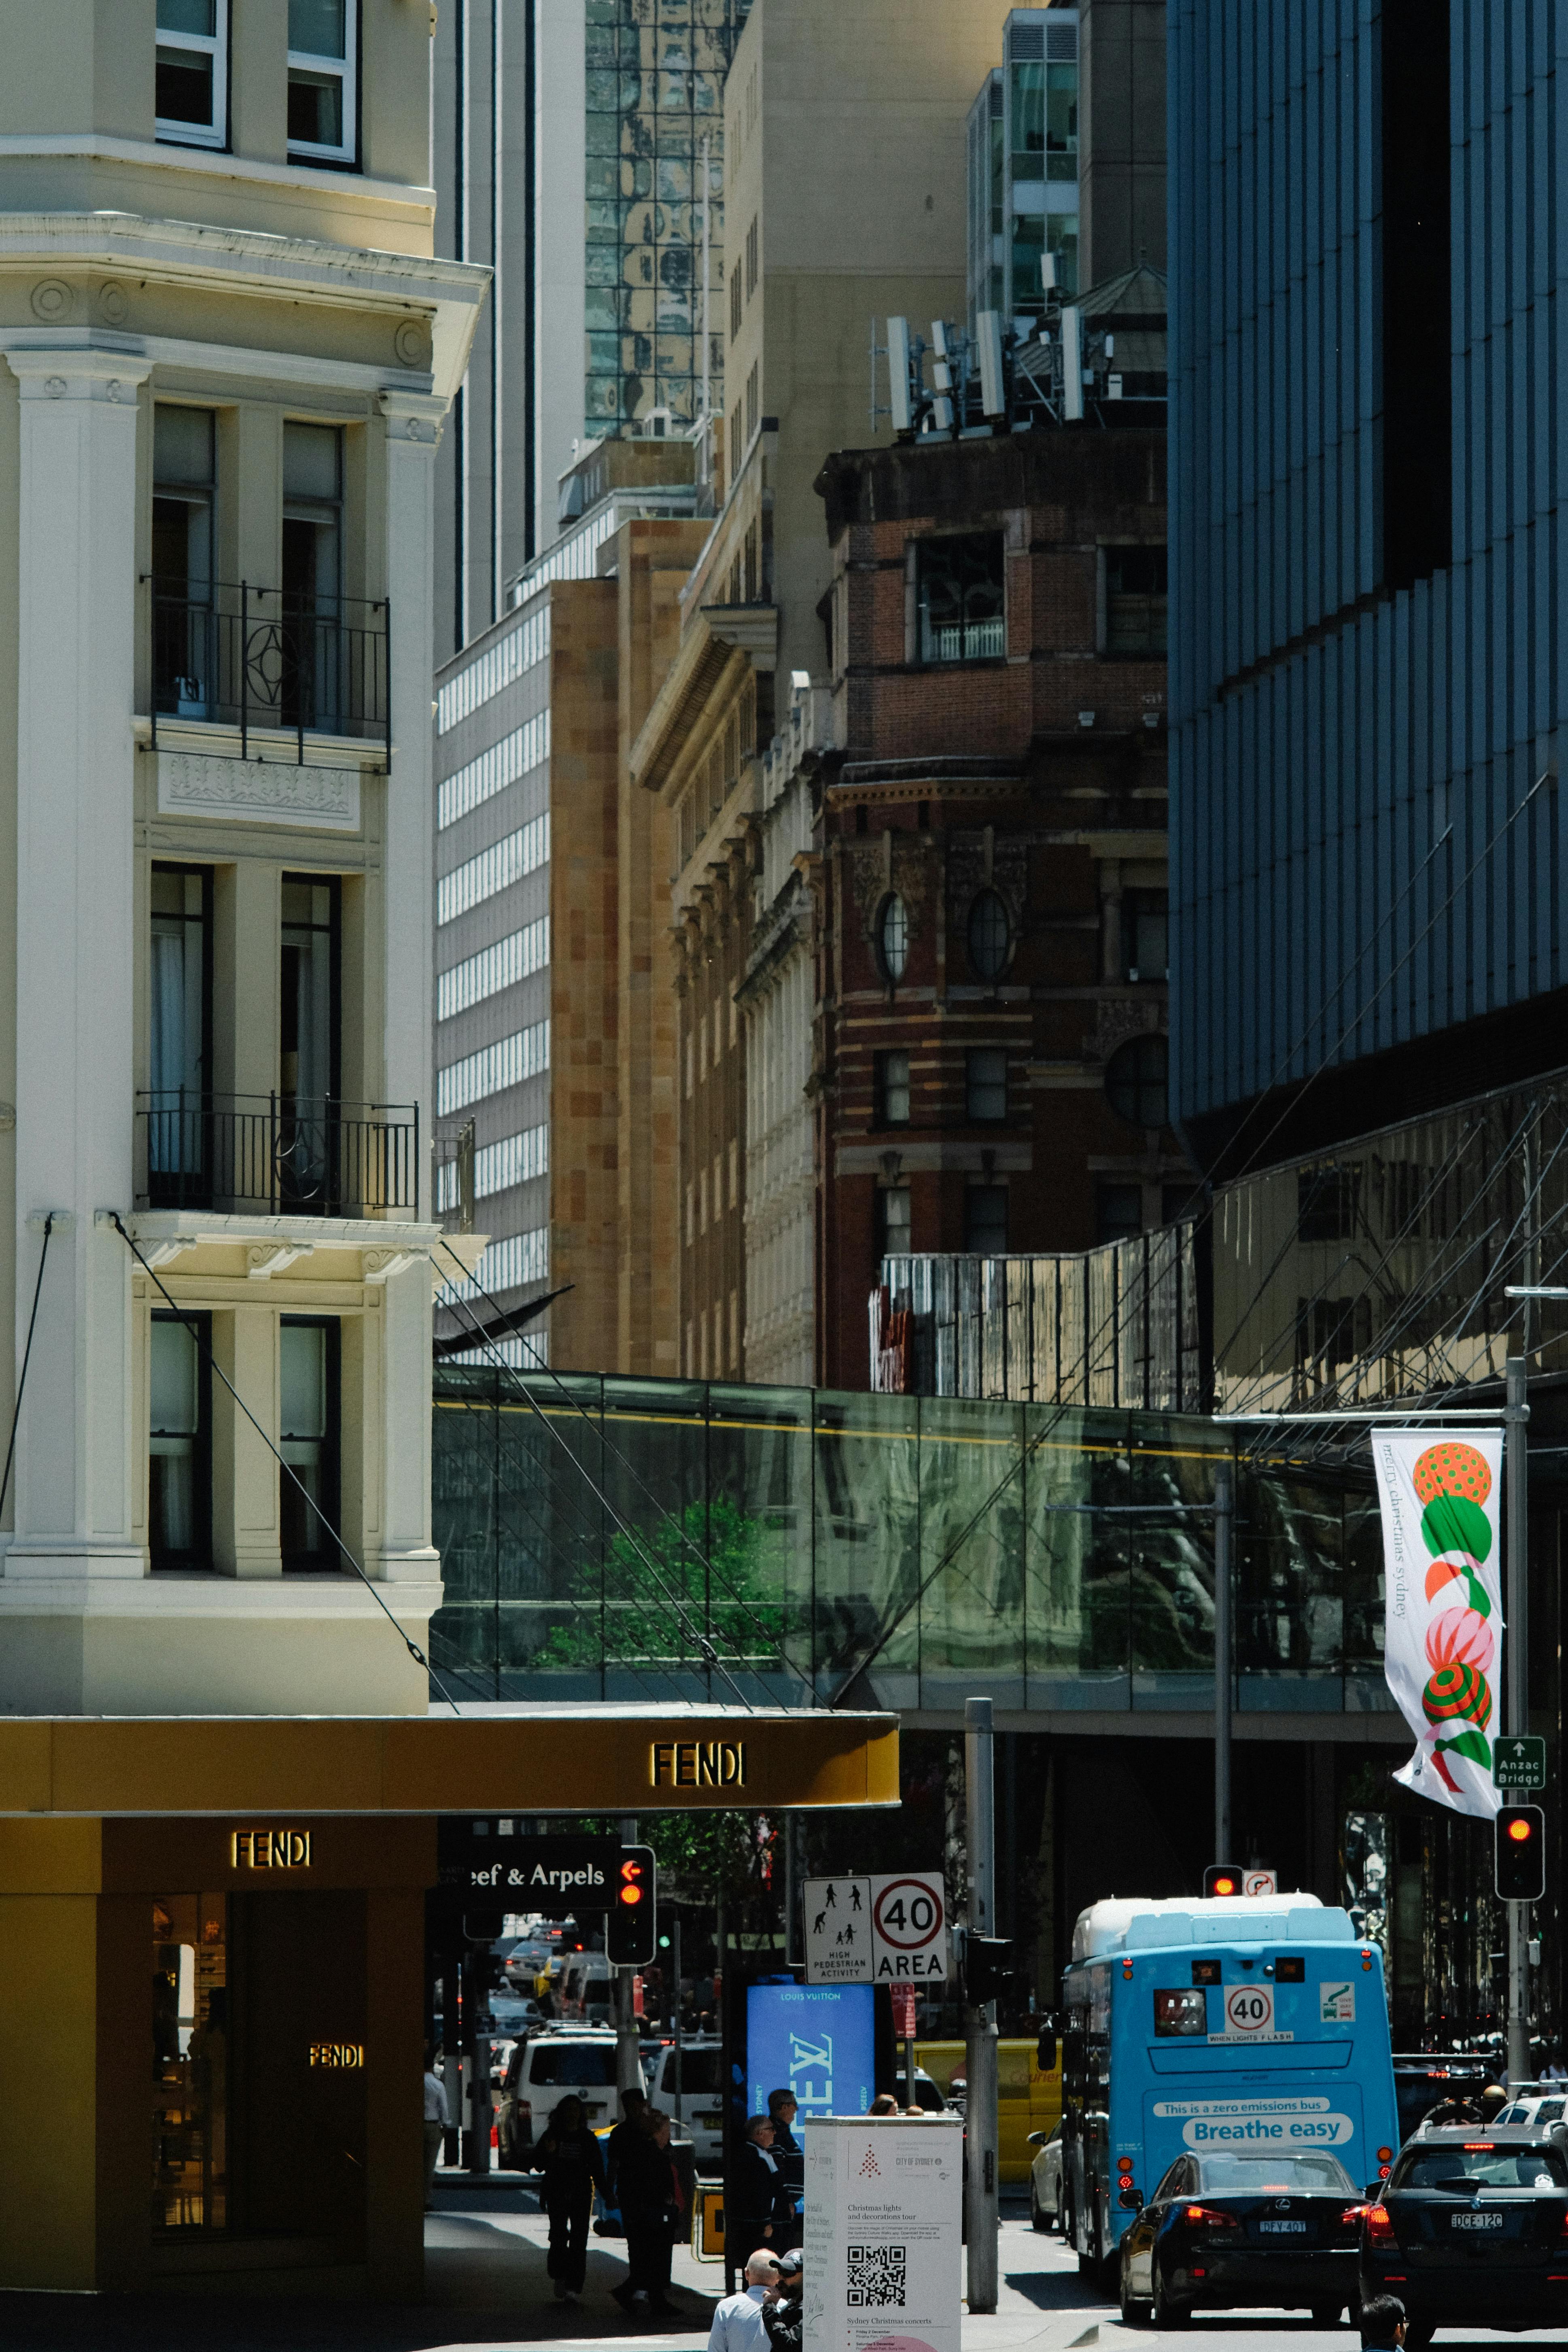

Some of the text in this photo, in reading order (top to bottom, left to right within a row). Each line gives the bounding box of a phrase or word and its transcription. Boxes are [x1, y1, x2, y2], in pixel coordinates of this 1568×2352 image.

[1383, 1444, 1409, 1619] merry christmas sydney
[650, 1743, 746, 1786] FENDI
[1500, 1760, 1539, 1770] Anzac
[1498, 1773, 1539, 1785] Bridge
[231, 1832, 314, 1867] FENDI
[507, 1868, 525, 1885] &
[530, 1863, 605, 1892] Arpels
[884, 1897, 933, 1931] 40
[814, 1959, 866, 1969] PEDESTRIAN
[829, 1951, 850, 1959] HIGH
[878, 1954, 943, 1976] AREA
[821, 1969, 860, 1977] ACTIVITY
[1234, 1998, 1263, 2019] 40
[309, 2044, 363, 2067] FENDI
[1164, 2104, 1187, 2114] This
[1190, 2104, 1199, 2113] is
[1241, 2101, 1296, 2112] emissions
[1301, 2100, 1321, 2110] bus
[1195, 2120, 1340, 2141] Breathe easy
[896, 2158, 907, 2166] CITY
[883, 2204, 902, 2212] lights
